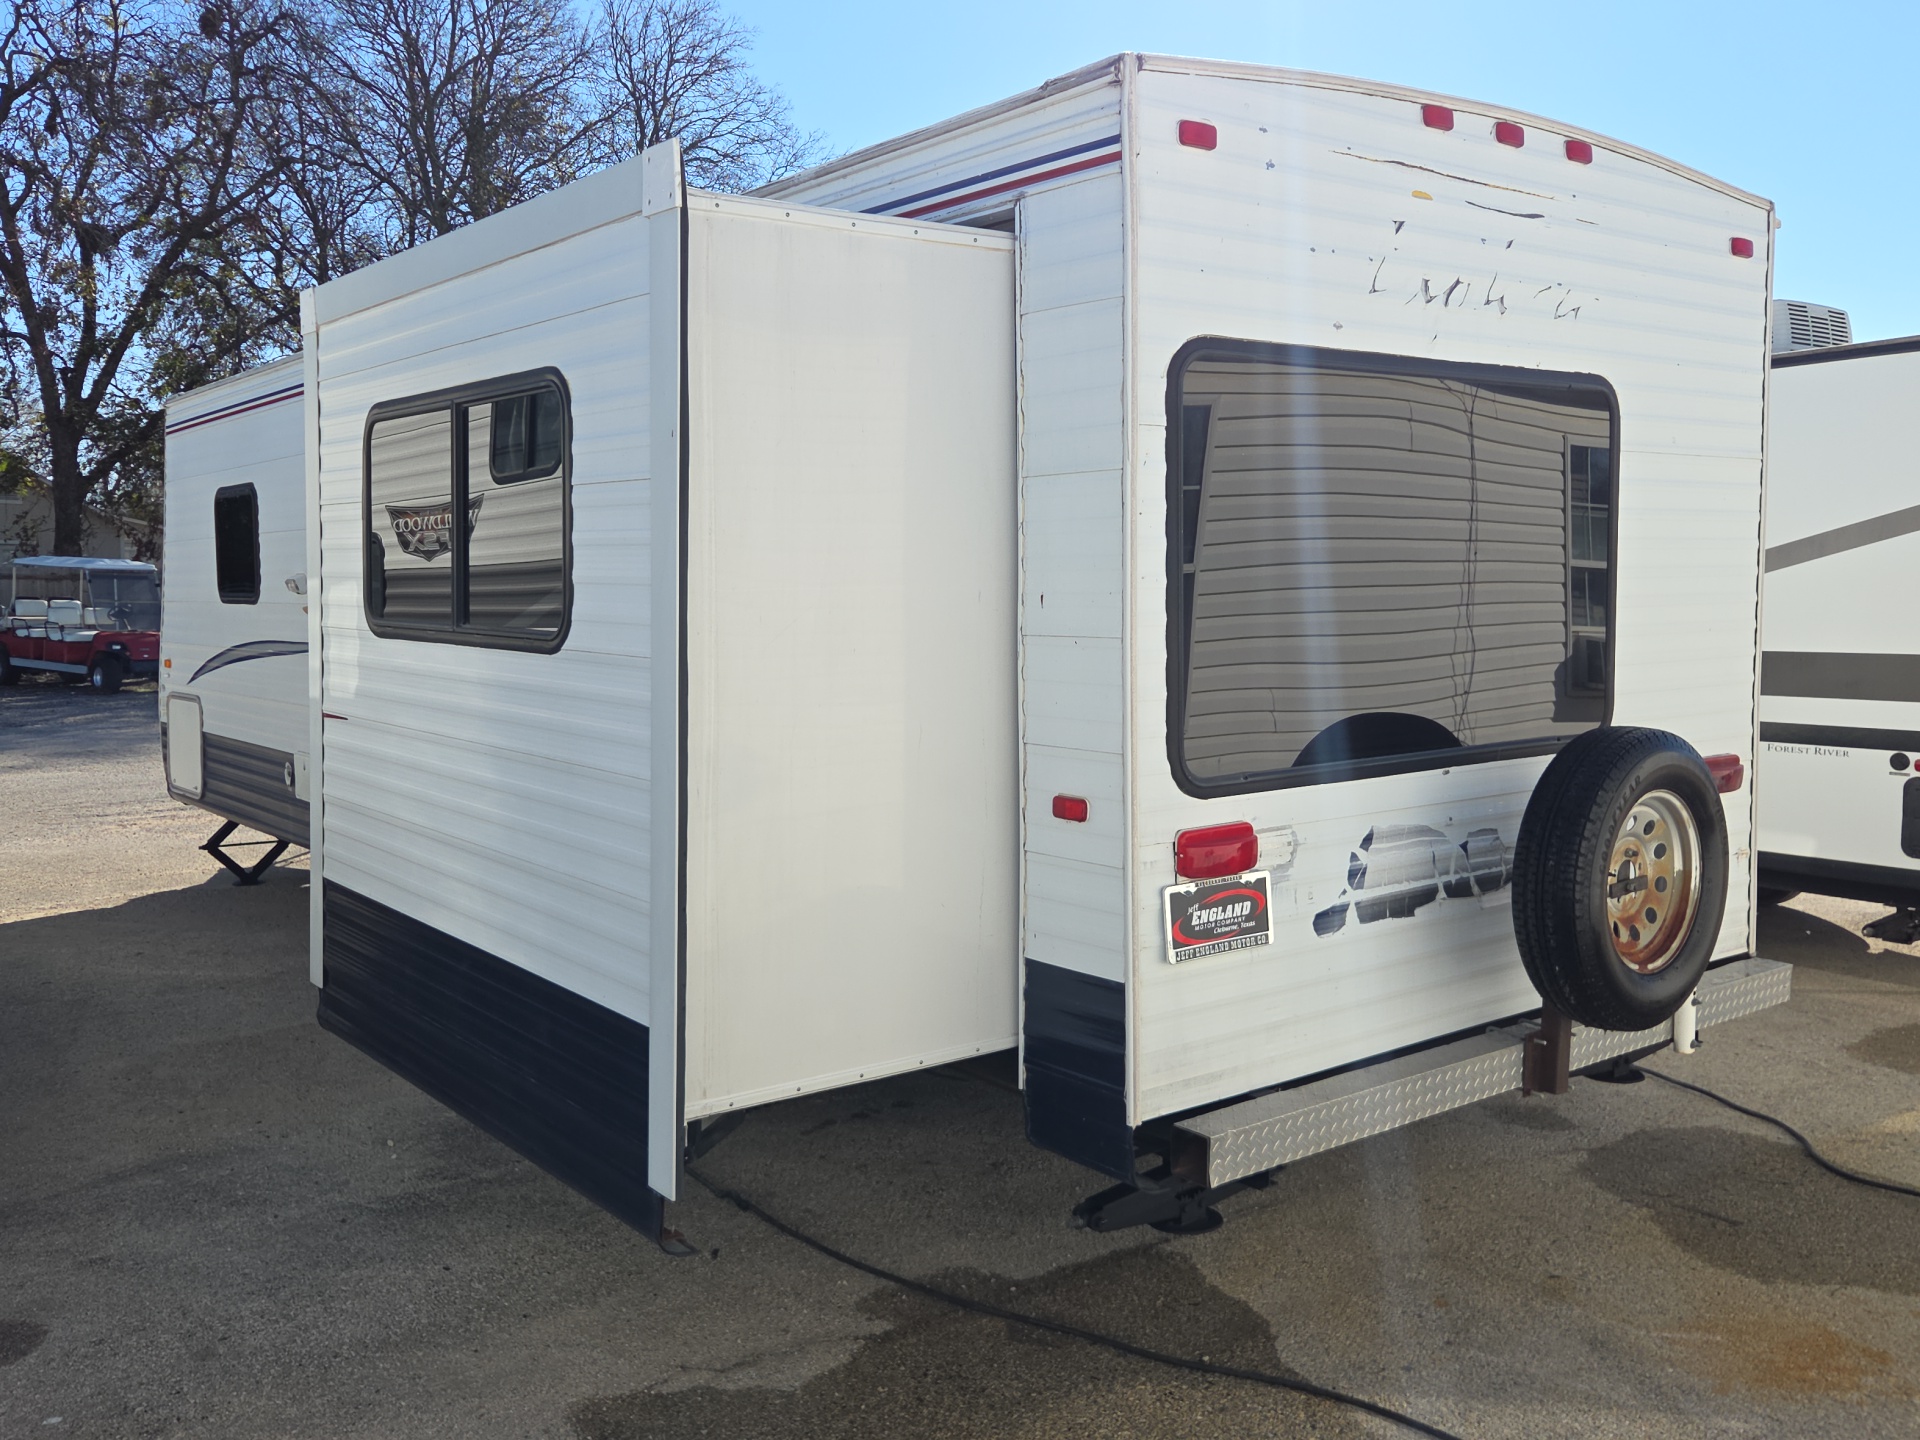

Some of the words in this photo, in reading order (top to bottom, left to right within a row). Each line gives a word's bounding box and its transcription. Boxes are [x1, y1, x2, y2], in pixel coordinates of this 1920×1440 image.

[1767, 743, 1811, 755] FOREST
[1814, 746, 1850, 758] RIVER
[1191, 901, 1251, 926] ENGLAND
[1194, 922, 1216, 932] MOTOR
[1216, 916, 1246, 927] COMPANY
[1176, 949, 1194, 961] JEFF
[1195, 941, 1229, 957] ENGLAND
[1230, 936, 1256, 950] MOTOR
